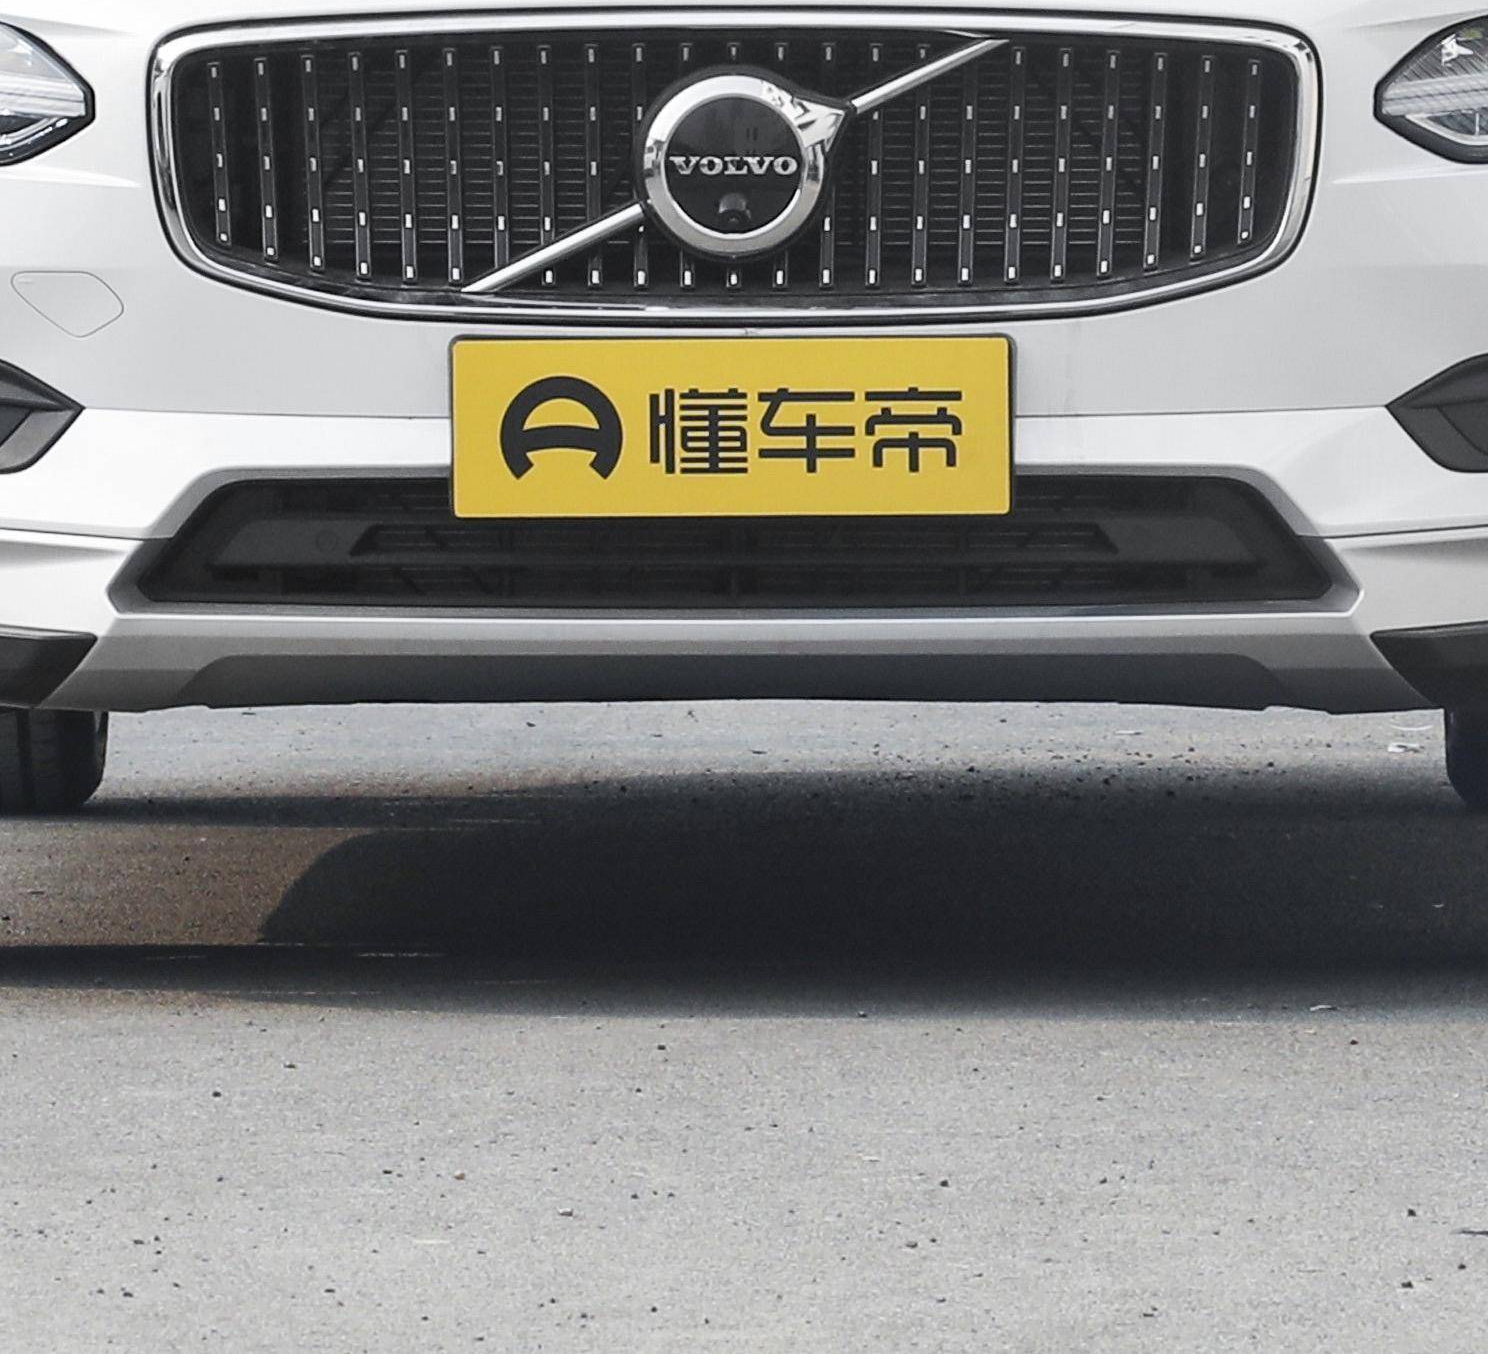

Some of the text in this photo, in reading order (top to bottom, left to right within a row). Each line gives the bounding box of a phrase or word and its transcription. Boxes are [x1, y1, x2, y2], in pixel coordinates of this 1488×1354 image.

[669, 155, 799, 176] VOLVO
[649, 386, 963, 475] 懂车帝
